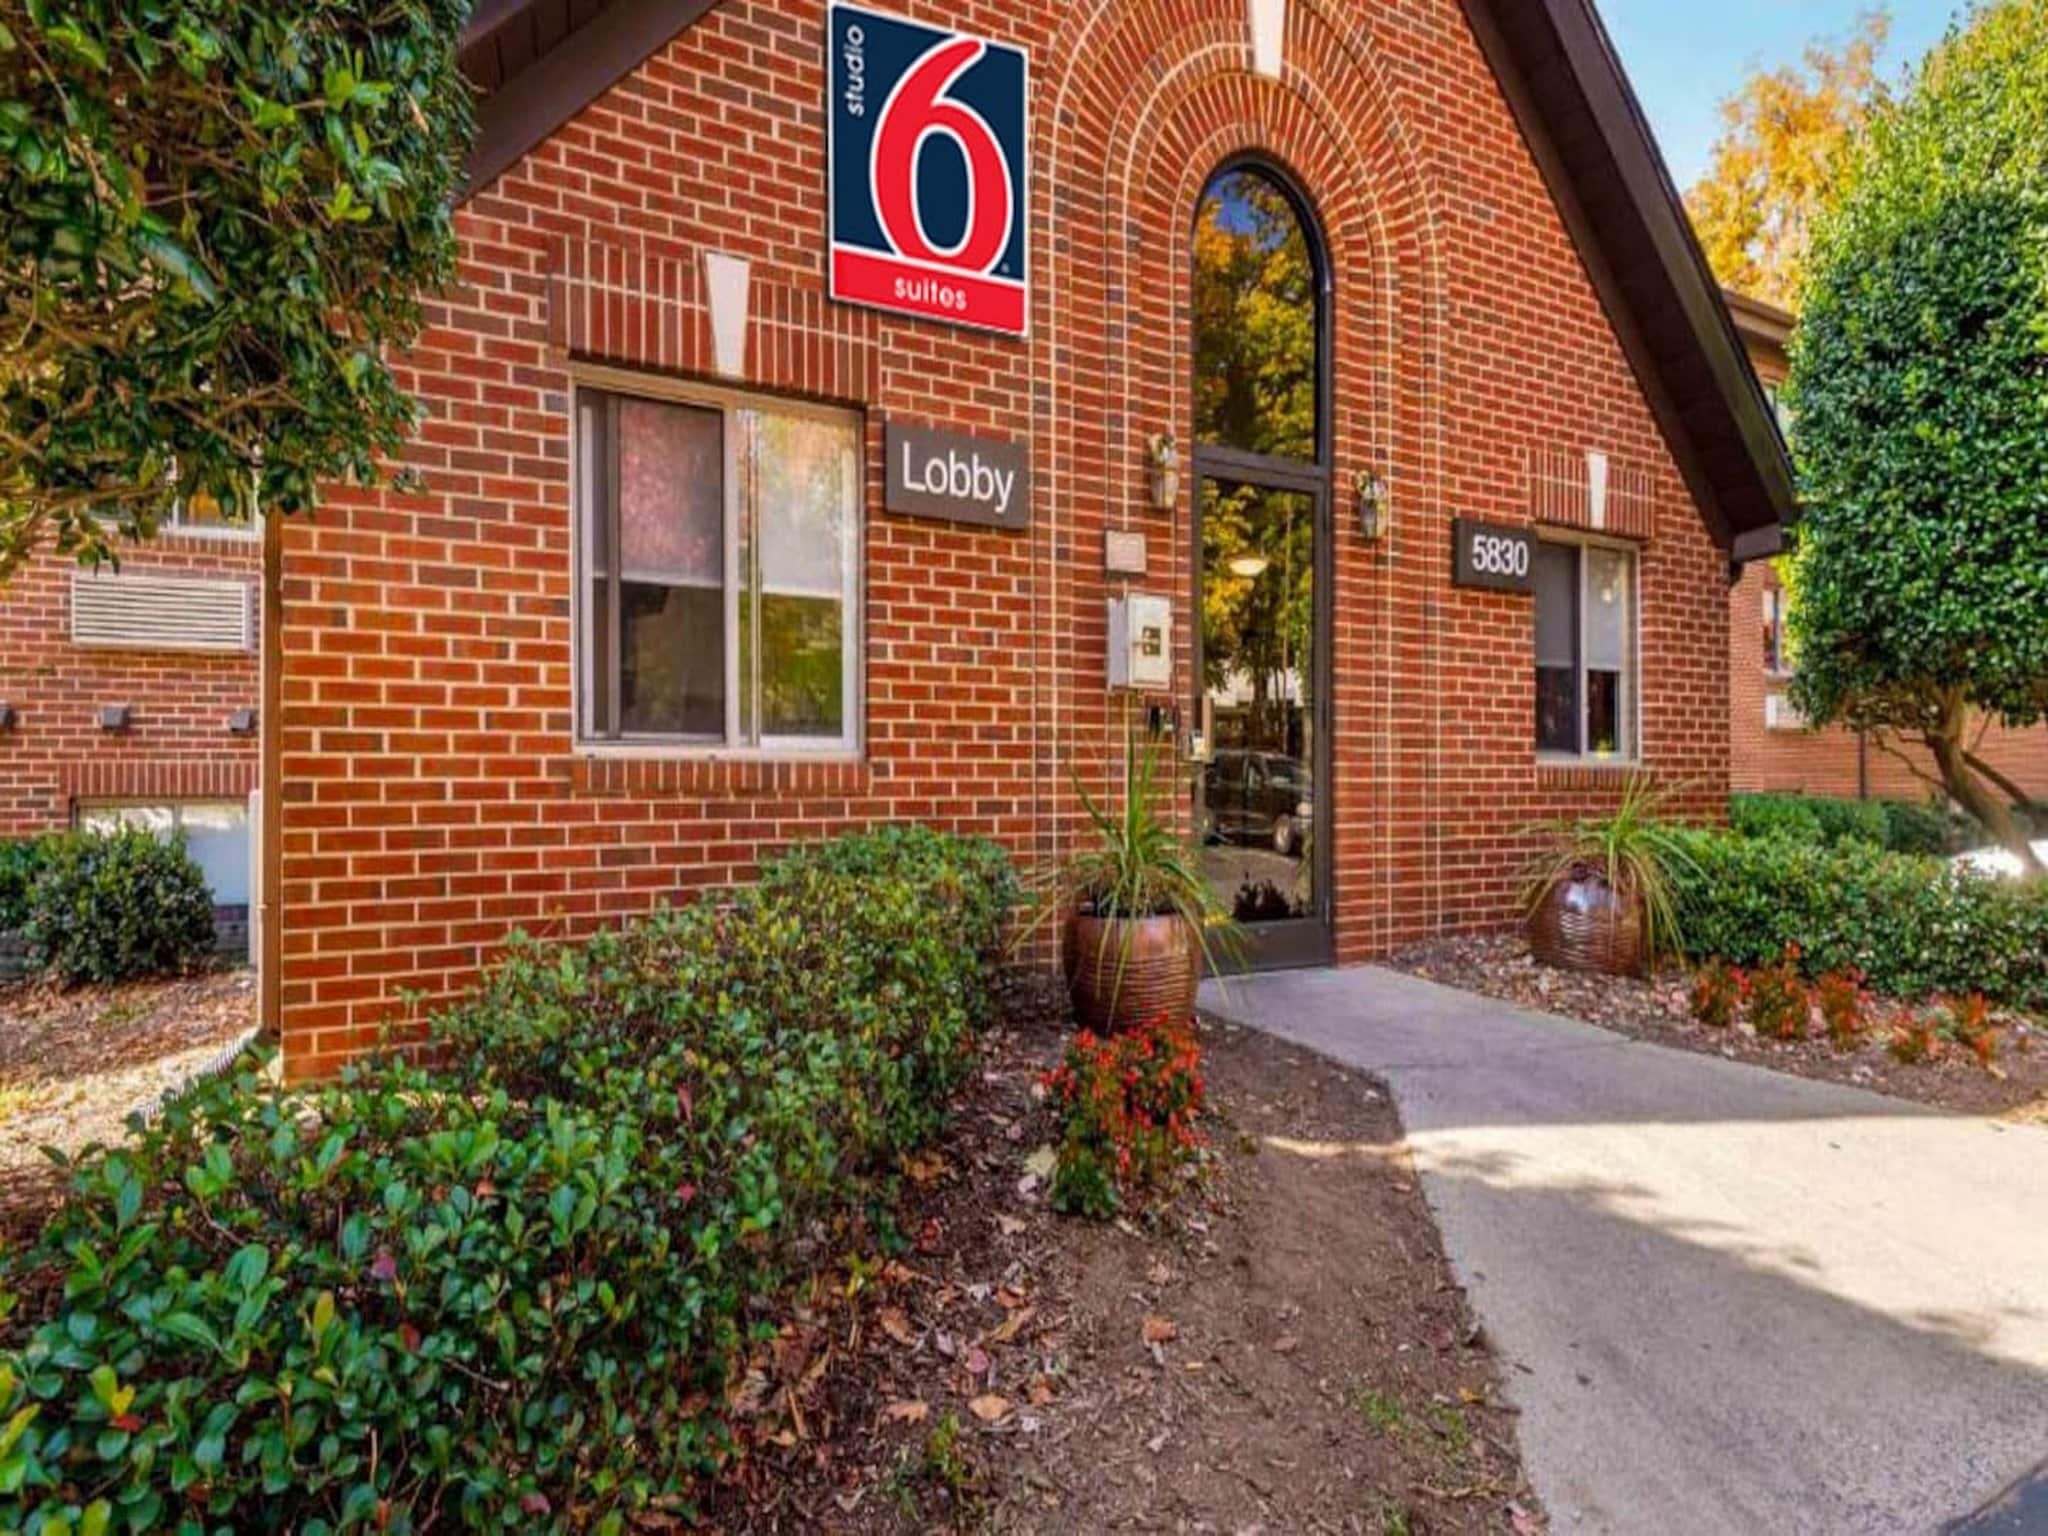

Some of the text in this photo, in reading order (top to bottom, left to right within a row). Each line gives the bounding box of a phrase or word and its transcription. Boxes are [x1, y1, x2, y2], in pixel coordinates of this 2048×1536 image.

[844, 25, 864, 117] studio
[870, 36, 1014, 274] 6
[894, 277, 968, 311] suites
[903, 440, 1014, 513] Lobby
[1472, 534, 1529, 577] 5830
